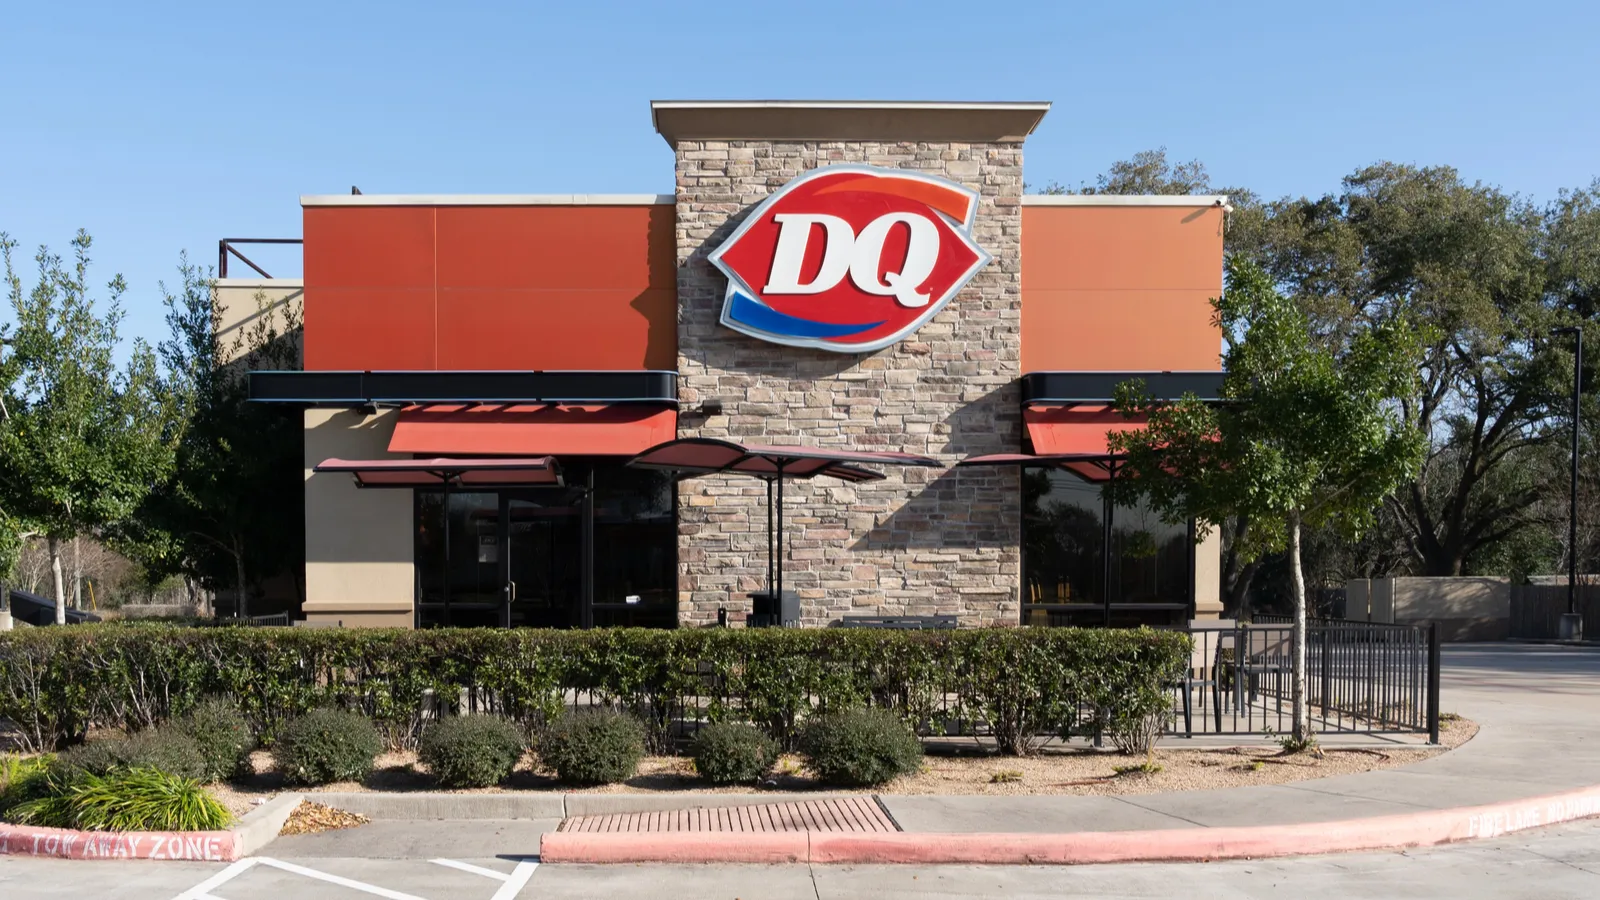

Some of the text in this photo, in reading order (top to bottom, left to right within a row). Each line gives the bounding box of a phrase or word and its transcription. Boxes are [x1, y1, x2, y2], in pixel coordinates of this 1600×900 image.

[763, 212, 940, 308] DQ
[1468, 814, 1503, 838] FIRE
[1505, 807, 1540, 832] LANE
[32, 833, 79, 856] TOW
[83, 834, 141, 858] AWAY
[150, 836, 221, 861] ZONE
